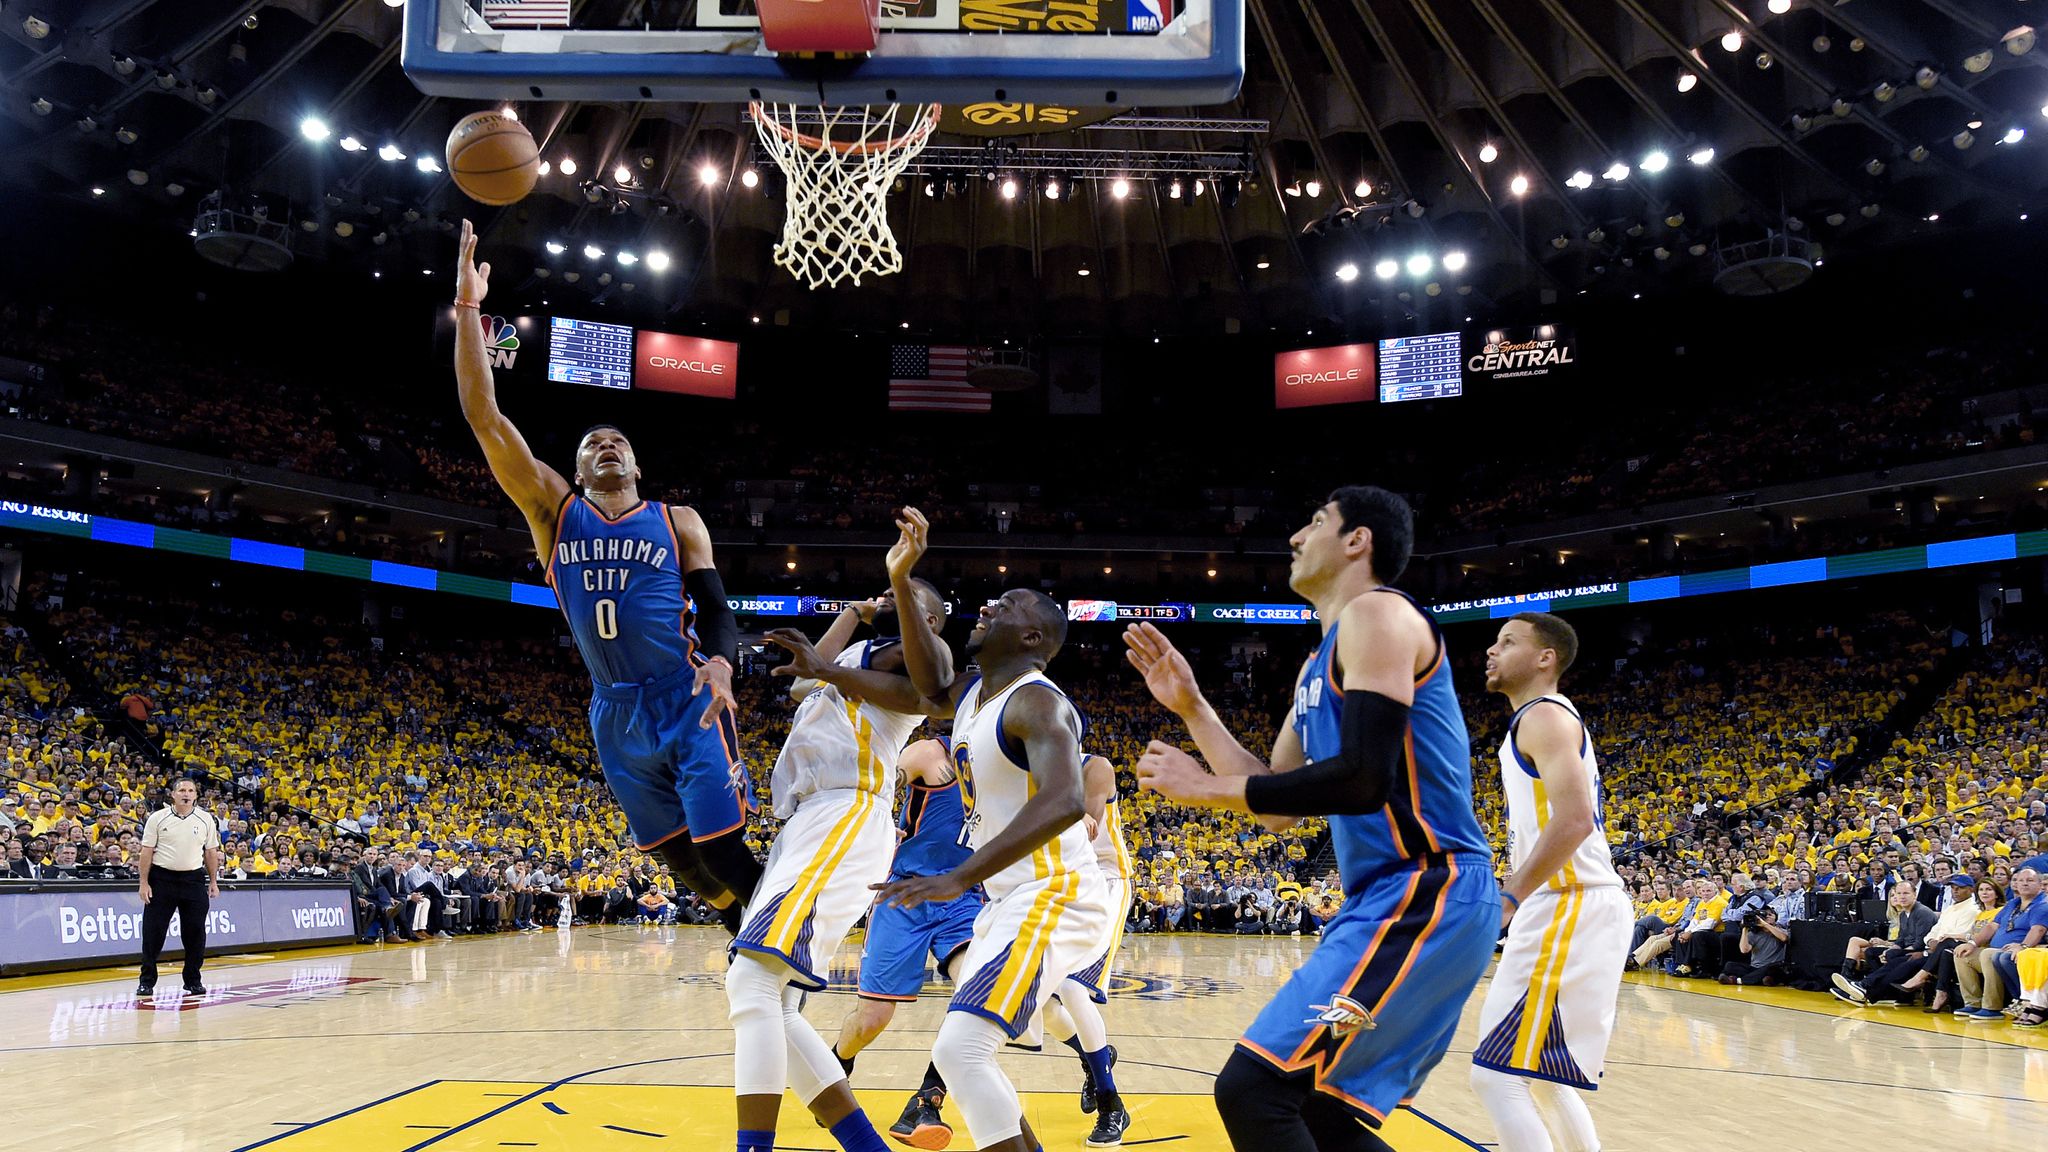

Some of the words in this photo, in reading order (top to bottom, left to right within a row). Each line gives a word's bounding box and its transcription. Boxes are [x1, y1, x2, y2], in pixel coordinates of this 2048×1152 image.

[1132, 16, 1158, 29] NBA
[486, 348, 517, 369] SN
[649, 356, 726, 375] ORACLE
[1468, 347, 1573, 372] CENTRAL
[1285, 369, 1362, 386] ORACLE
[558, 538, 668, 569] OKLAHOMA
[583, 568, 629, 592] CITY
[741, 600, 785, 611] RESORT
[1118, 608, 1134, 616] TOL
[1156, 609, 1166, 617] TF
[1213, 607, 1255, 619] CACHE
[1258, 608, 1298, 619] CREEK
[595, 599, 618, 640] 0
[60, 906, 143, 944] Better
[291, 904, 345, 929] verizon
